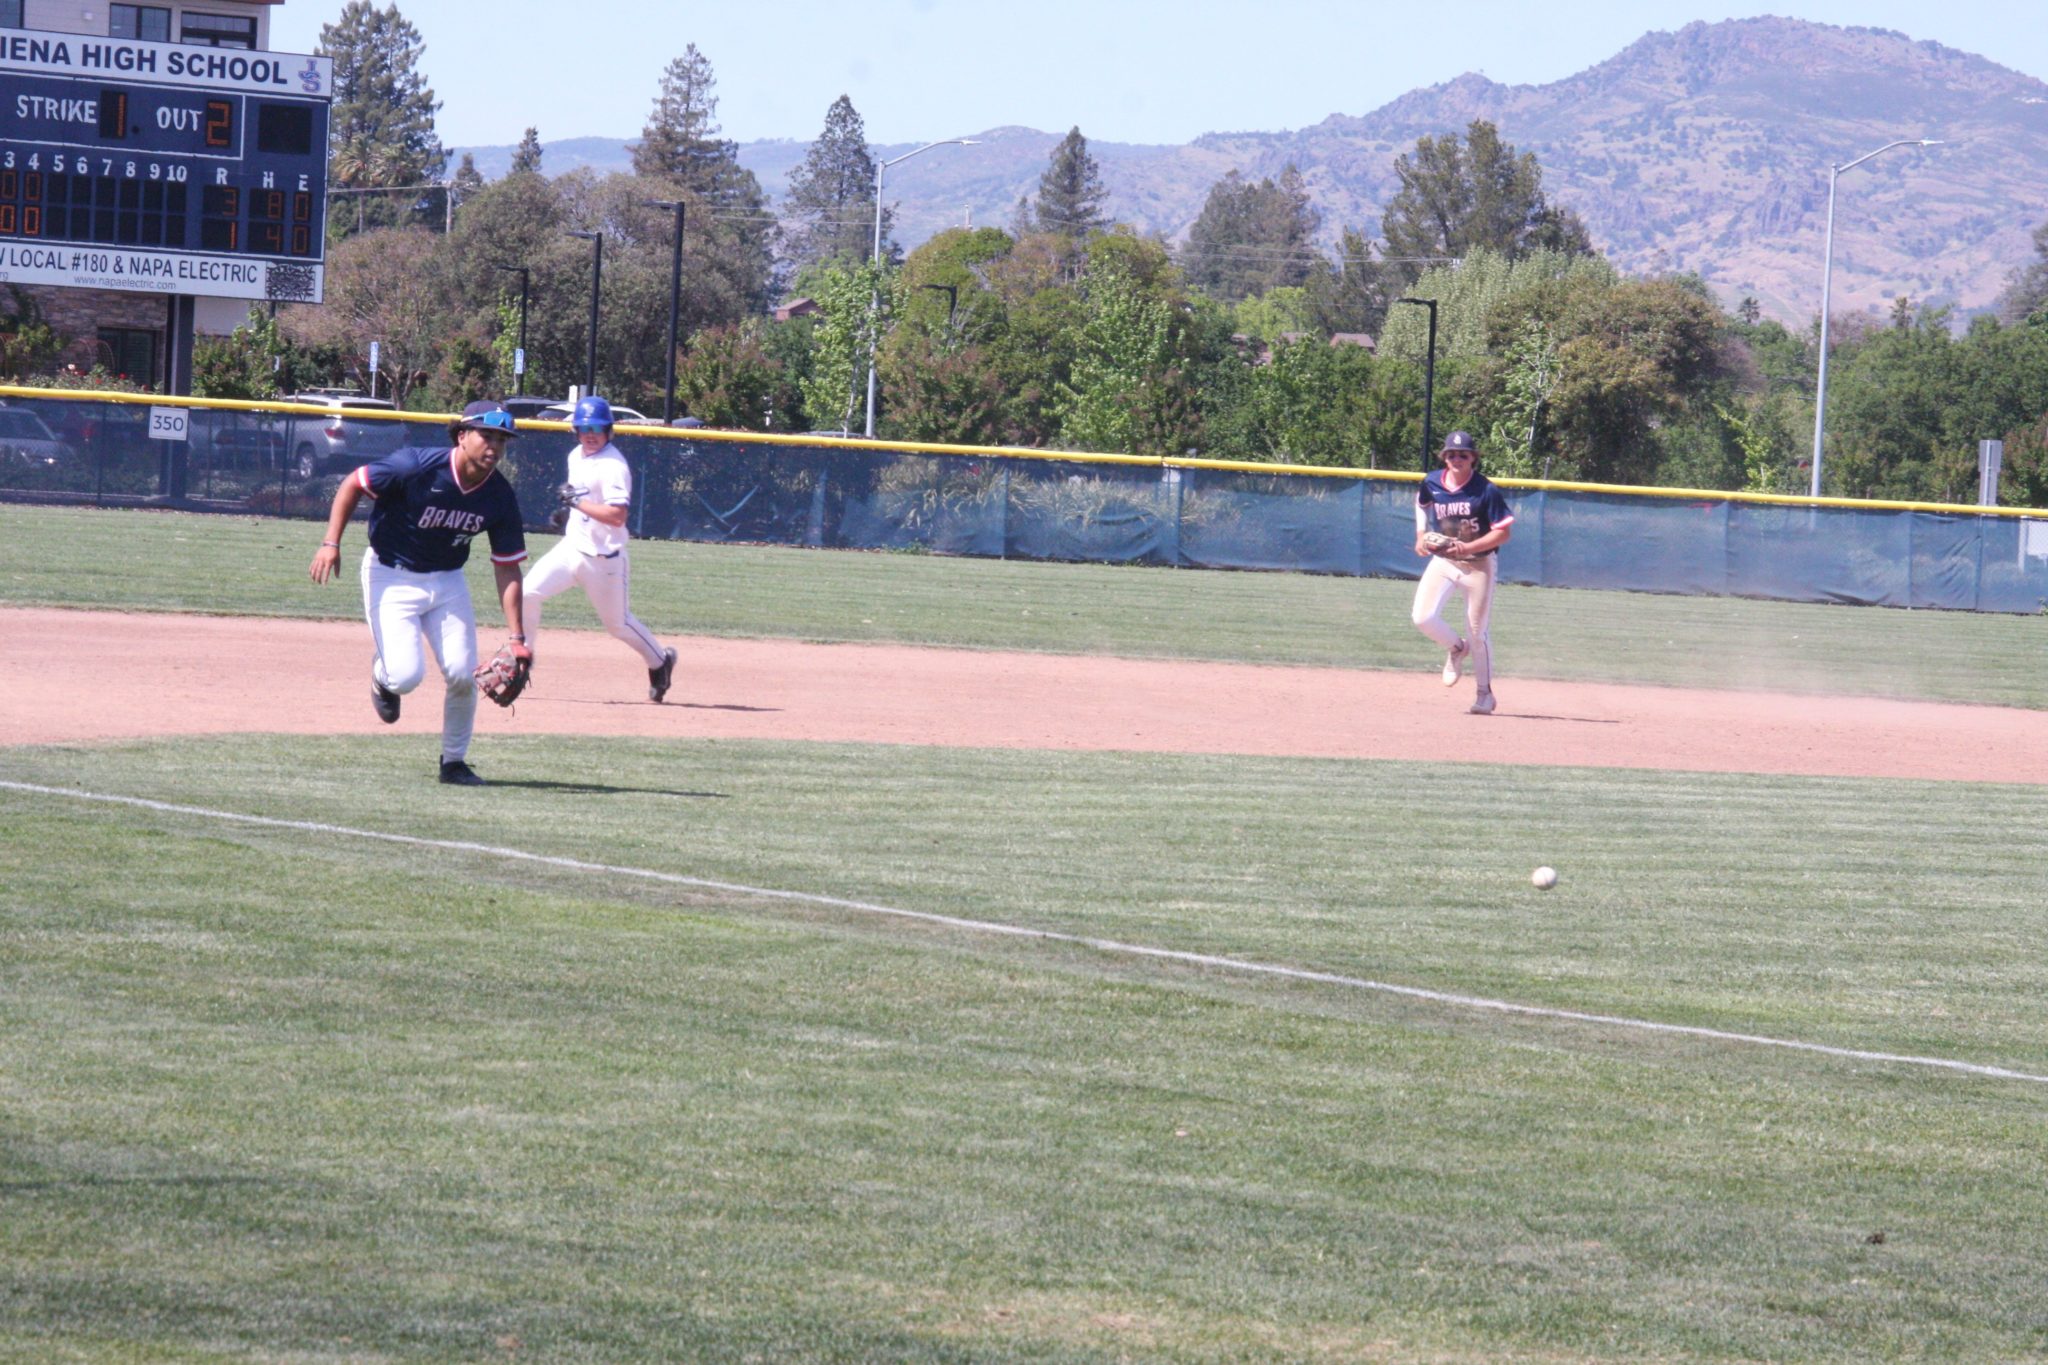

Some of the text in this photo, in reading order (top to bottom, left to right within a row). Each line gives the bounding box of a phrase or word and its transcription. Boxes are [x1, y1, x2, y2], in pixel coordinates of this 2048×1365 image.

[0, 36, 288, 84] IENA HIGH SCHOOL
[16, 94, 98, 124] STRIKE
[156, 106, 203, 131] OUT
[207, 102, 230, 145] 2
[4, 151, 187, 183] 3 4 5 6 7 8 9 10
[216, 167, 229, 185] R
[262, 171, 274, 189] H
[298, 174, 309, 192] E
[10, 248, 67, 271] LOCAL
[71, 252, 108, 273] #180
[113, 255, 124, 274] &
[129, 256, 173, 278] NAPA
[178, 259, 258, 284] ELECTRIC
[73, 274, 177, 291] www.napaelectric.com
[153, 415, 184, 431] 350
[418, 506, 484, 532] BRAVES
